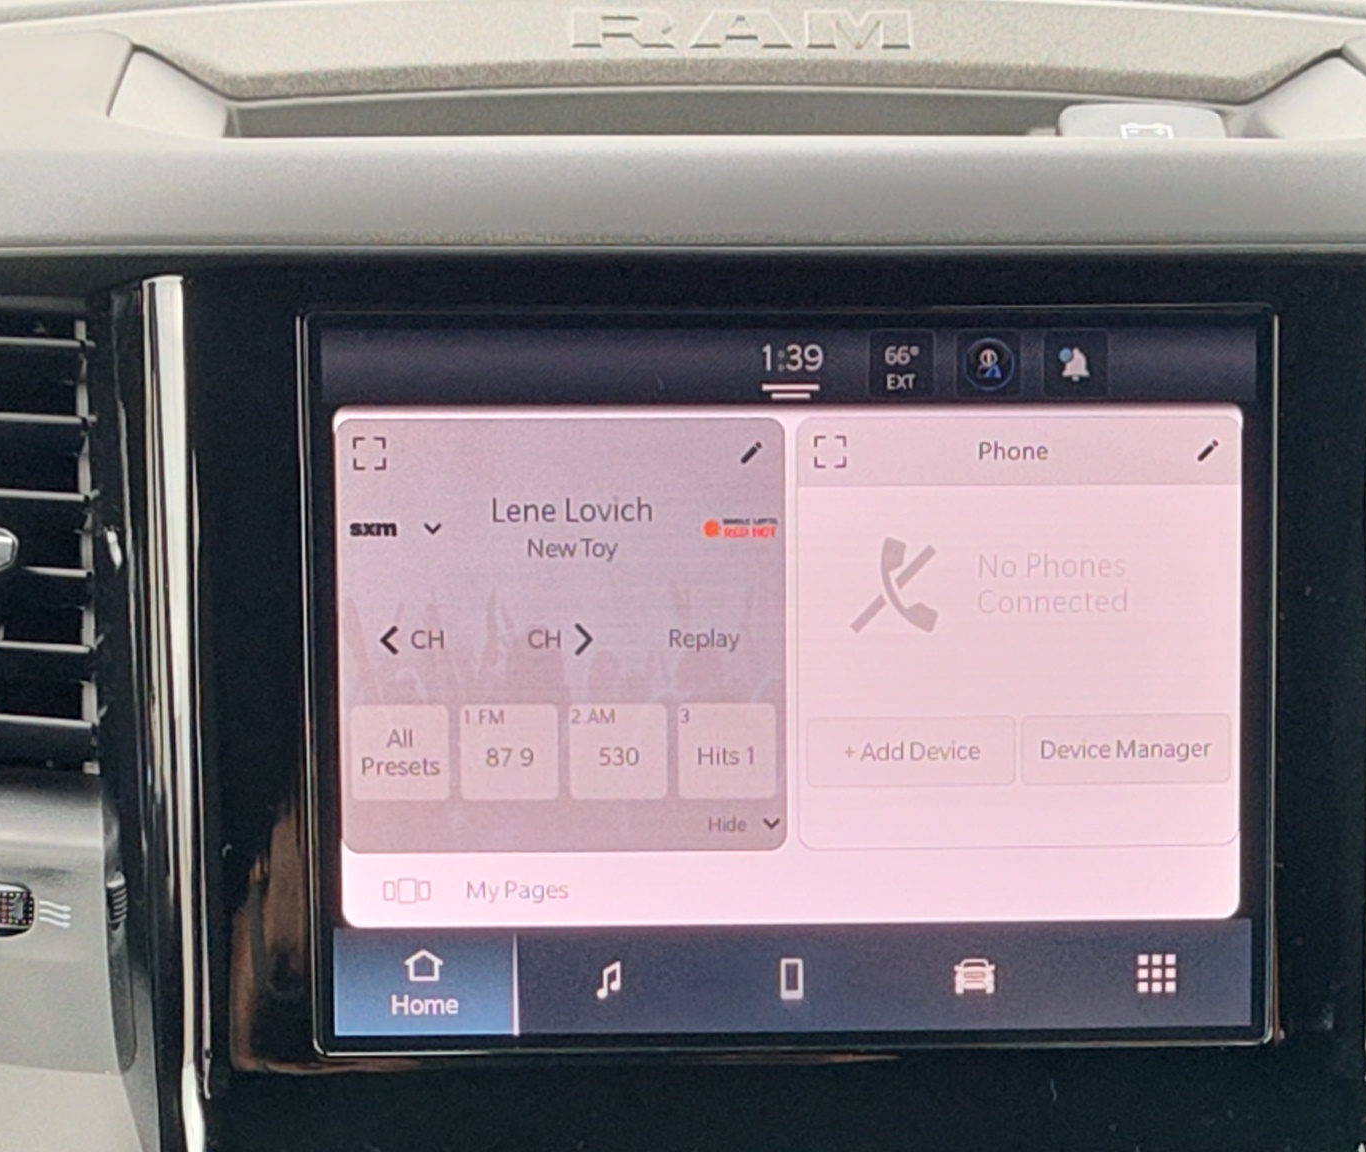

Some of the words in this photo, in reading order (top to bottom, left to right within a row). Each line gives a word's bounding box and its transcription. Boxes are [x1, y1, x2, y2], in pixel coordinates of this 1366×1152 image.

[571, 8, 912, 50] RAM
[761, 344, 824, 372] 1:39
[886, 374, 916, 390] EXT
[978, 442, 1049, 460] Phone
[492, 498, 557, 523] Lene
[565, 496, 653, 524] Lovich
[349, 521, 398, 538] sxm
[528, 538, 576, 558] New
[580, 538, 619, 562] Toy
[978, 554, 1017, 578] No
[1026, 553, 1127, 578] Phones
[978, 589, 1129, 614] Connected
[411, 629, 445, 650] CH
[528, 629, 562, 650] CH
[669, 627, 741, 652] Replay
[679, 708, 691, 725] 3
[386, 728, 414, 749] All
[599, 746, 640, 768] 530
[696, 745, 740, 767] Hits
[747, 745, 756, 766] 1
[860, 742, 905, 762] Add
[909, 742, 982, 762] Device
[1039, 739, 1112, 760] Device
[1115, 738, 1213, 764] Manager
[360, 755, 441, 777] Presets
[707, 817, 748, 834] Hide
[465, 880, 501, 901] My
[504, 879, 570, 902] Pages
[390, 993, 460, 1016] Home
